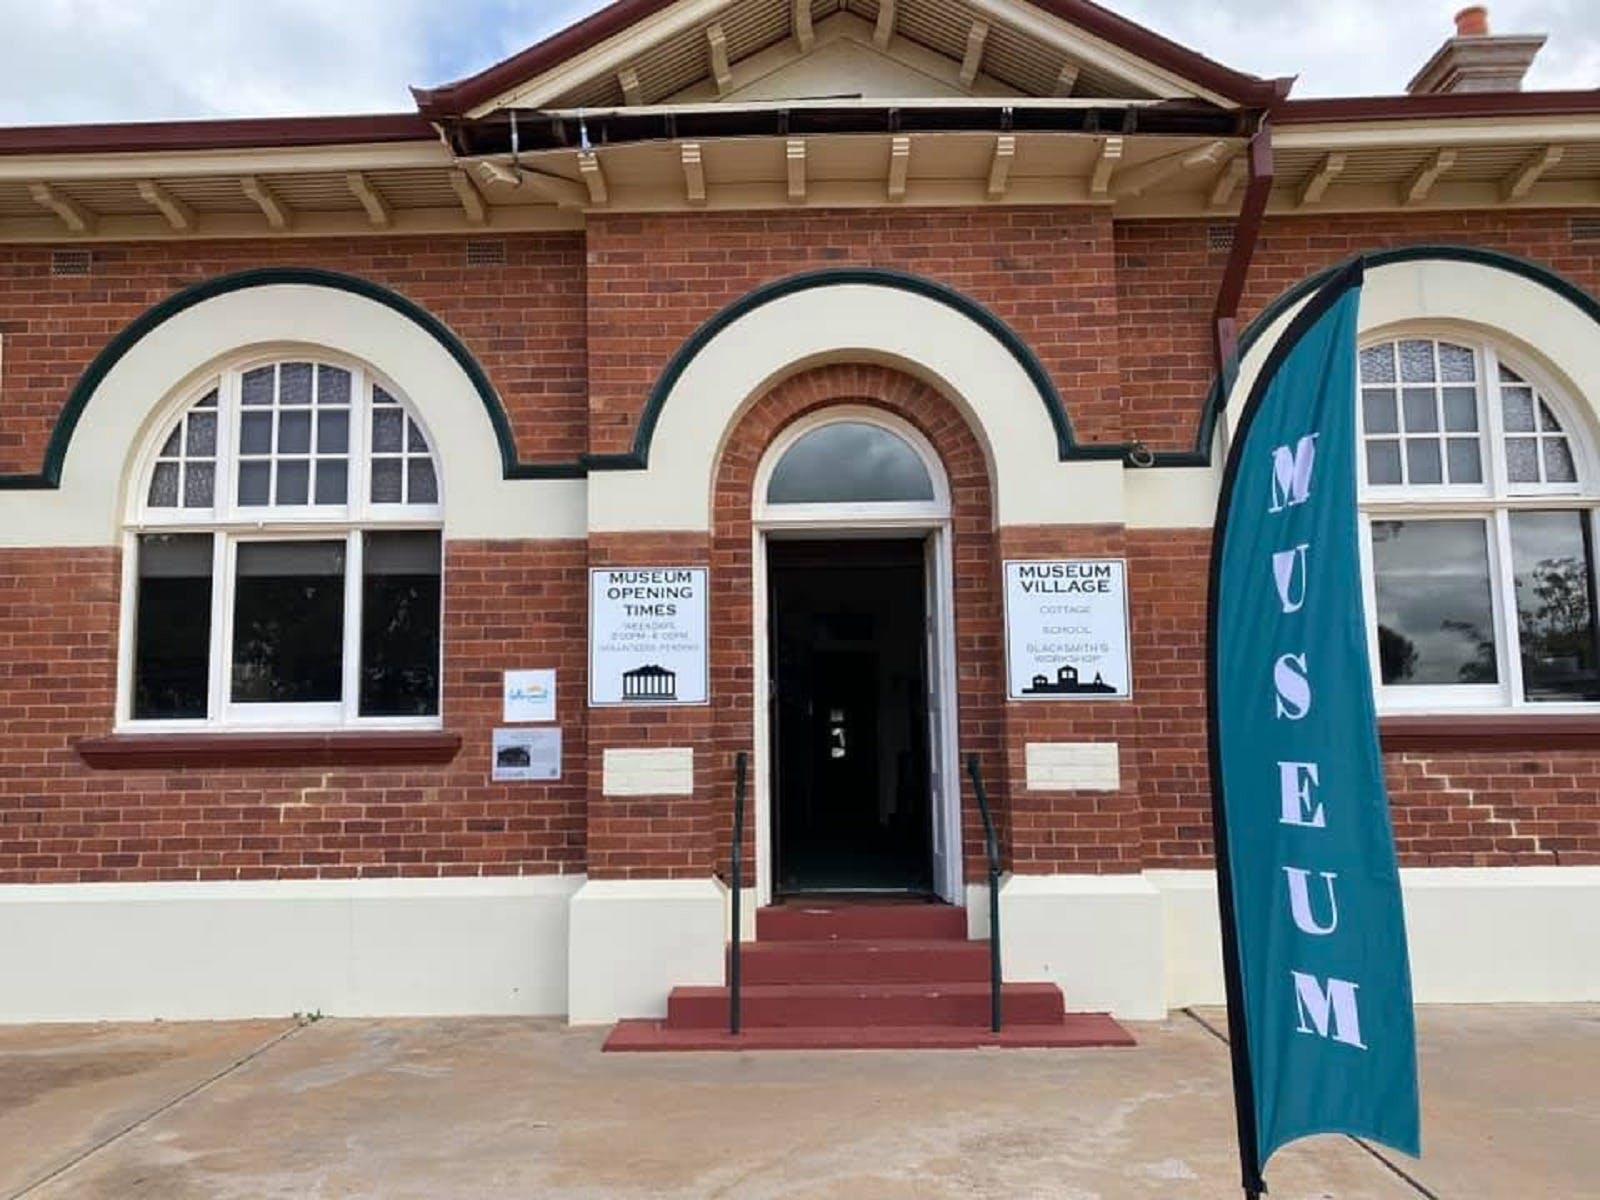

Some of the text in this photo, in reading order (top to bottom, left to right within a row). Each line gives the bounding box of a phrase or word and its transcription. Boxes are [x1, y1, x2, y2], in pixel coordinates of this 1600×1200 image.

[609, 571, 692, 584] MUSEUM
[1019, 564, 1111, 578] MUSEUM
[607, 586, 693, 600] OPENING
[1020, 580, 1111, 593] VILLAGE
[624, 604, 677, 616] TIMES
[1269, 433, 1368, 1051] MUSEUM
